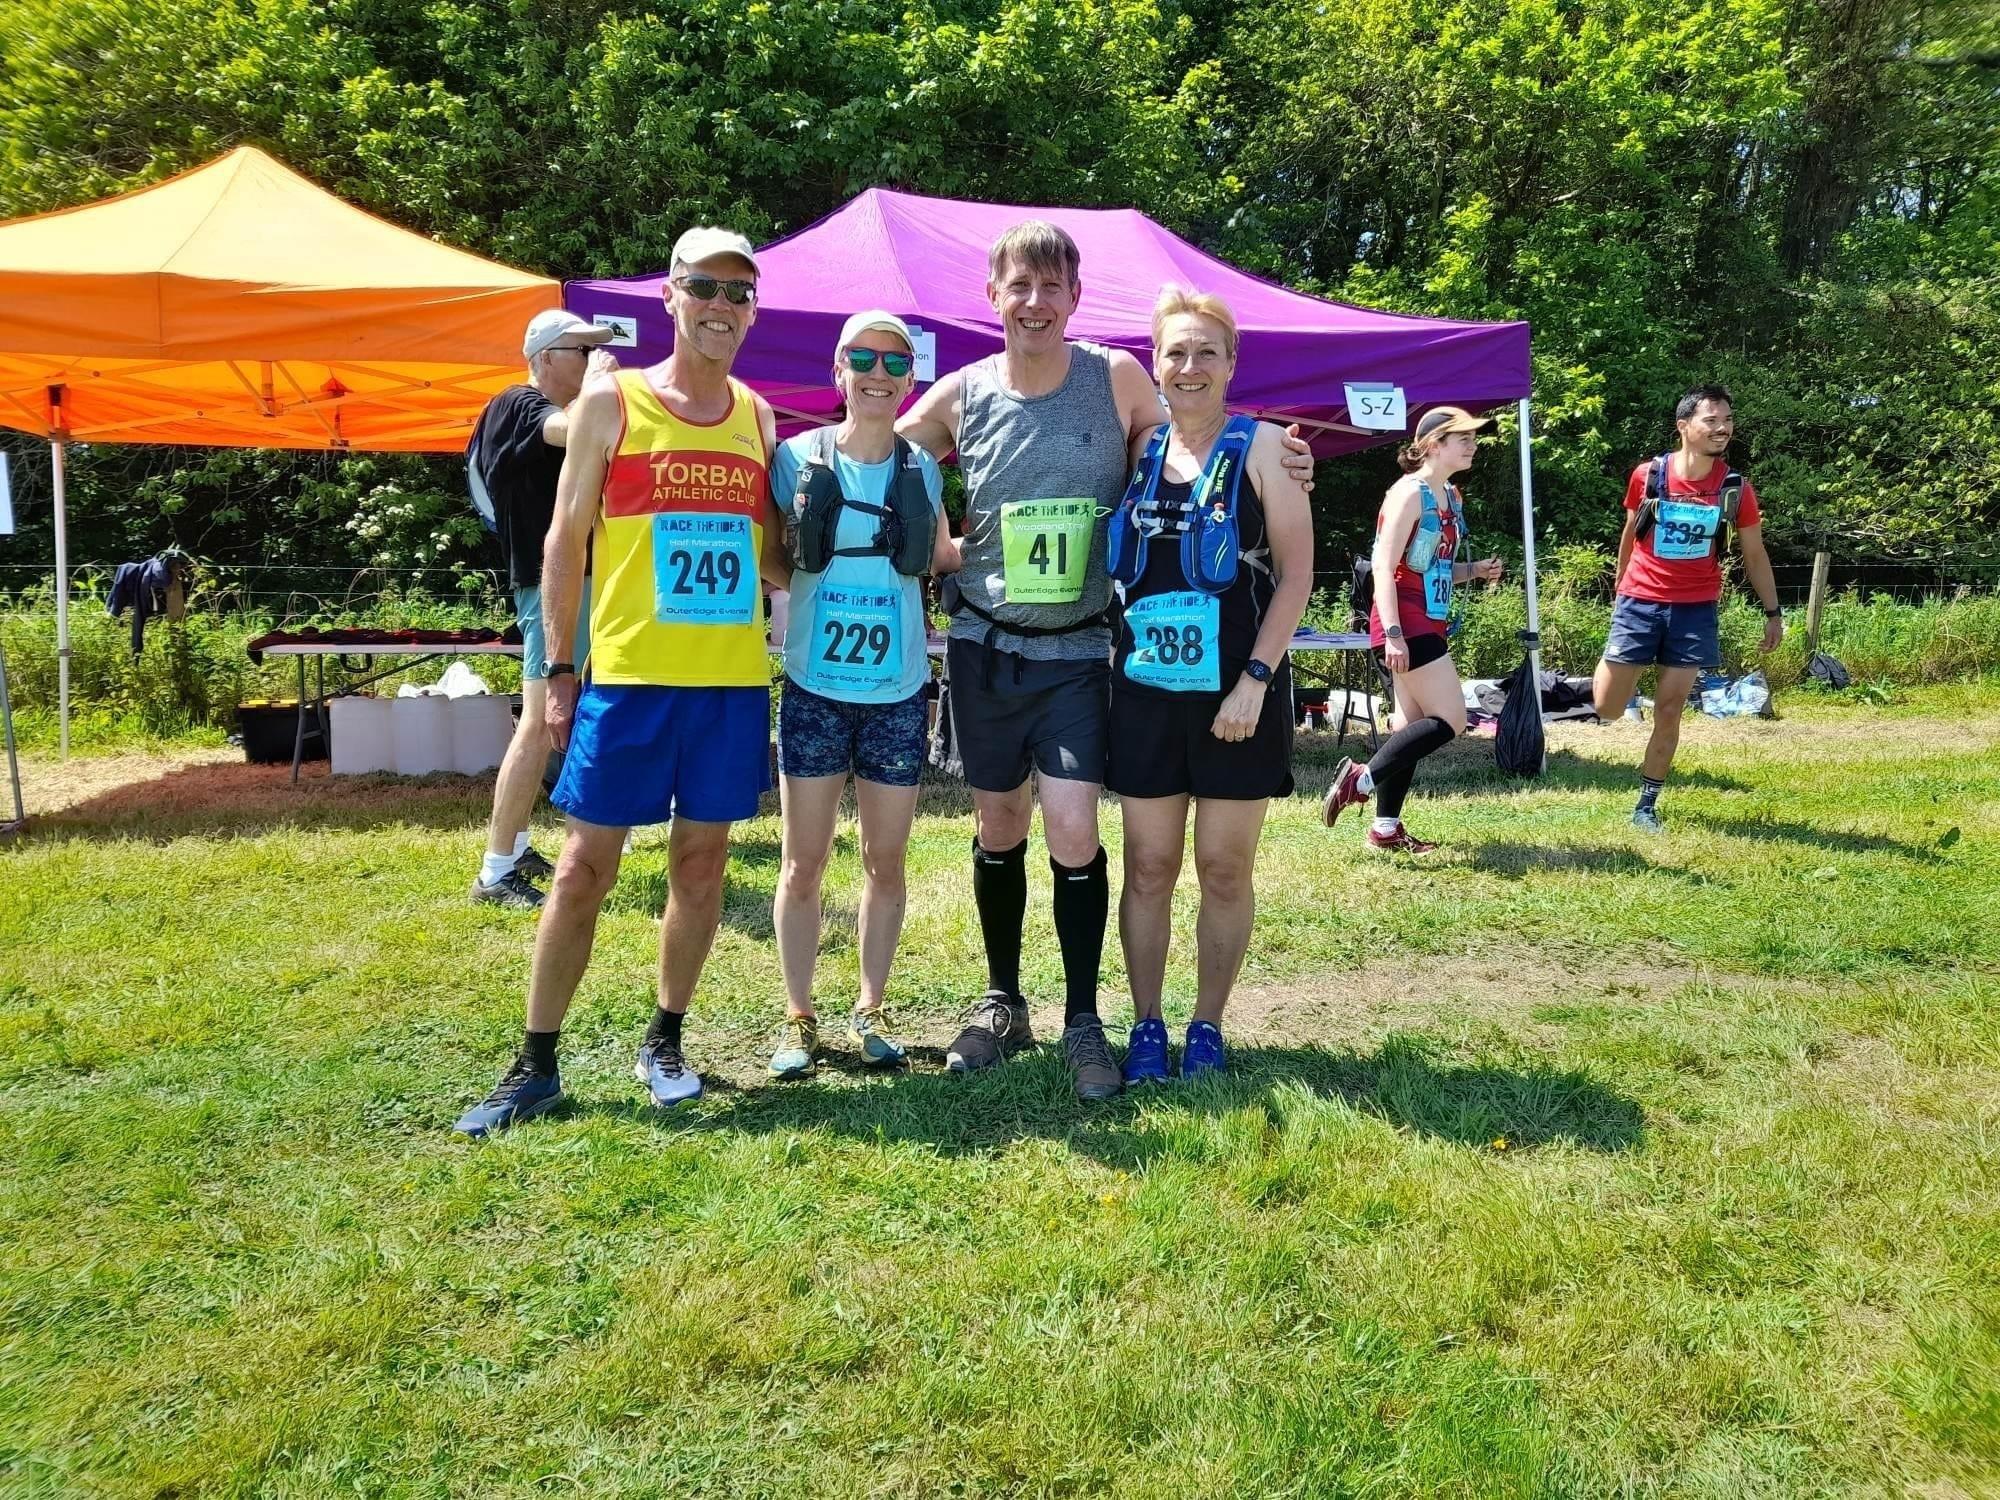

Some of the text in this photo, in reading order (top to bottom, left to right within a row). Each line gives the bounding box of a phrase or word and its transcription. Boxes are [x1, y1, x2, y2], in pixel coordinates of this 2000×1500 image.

[1361, 397, 1394, 416] S-Z
[650, 462, 755, 491] TORBAY
[652, 486, 756, 507] ATHLETIC CLUB
[1042, 504, 1059, 517] THE
[1060, 503, 1080, 516] TIDE
[660, 519, 736, 533] RACE THE TIDE
[1014, 523, 1065, 531] Woodland
[1662, 520, 1706, 544] 232
[669, 538, 741, 548] Half Marathon
[1028, 532, 1067, 574] 41
[670, 550, 740, 594] 249
[1013, 587, 1058, 595] OuterEdge
[822, 590, 890, 608] RACE THE TIDE
[1132, 596, 1200, 613] RACE THE TIDE
[666, 608, 717, 616] OuterEdge
[826, 609, 893, 621] Half Marathon
[1156, 614, 1206, 624] Marathon
[822, 620, 891, 666] 229
[1138, 624, 1204, 666] 288
[816, 671, 863, 684] OuterEdge
[1133, 672, 1212, 684] OuterEdge Events
